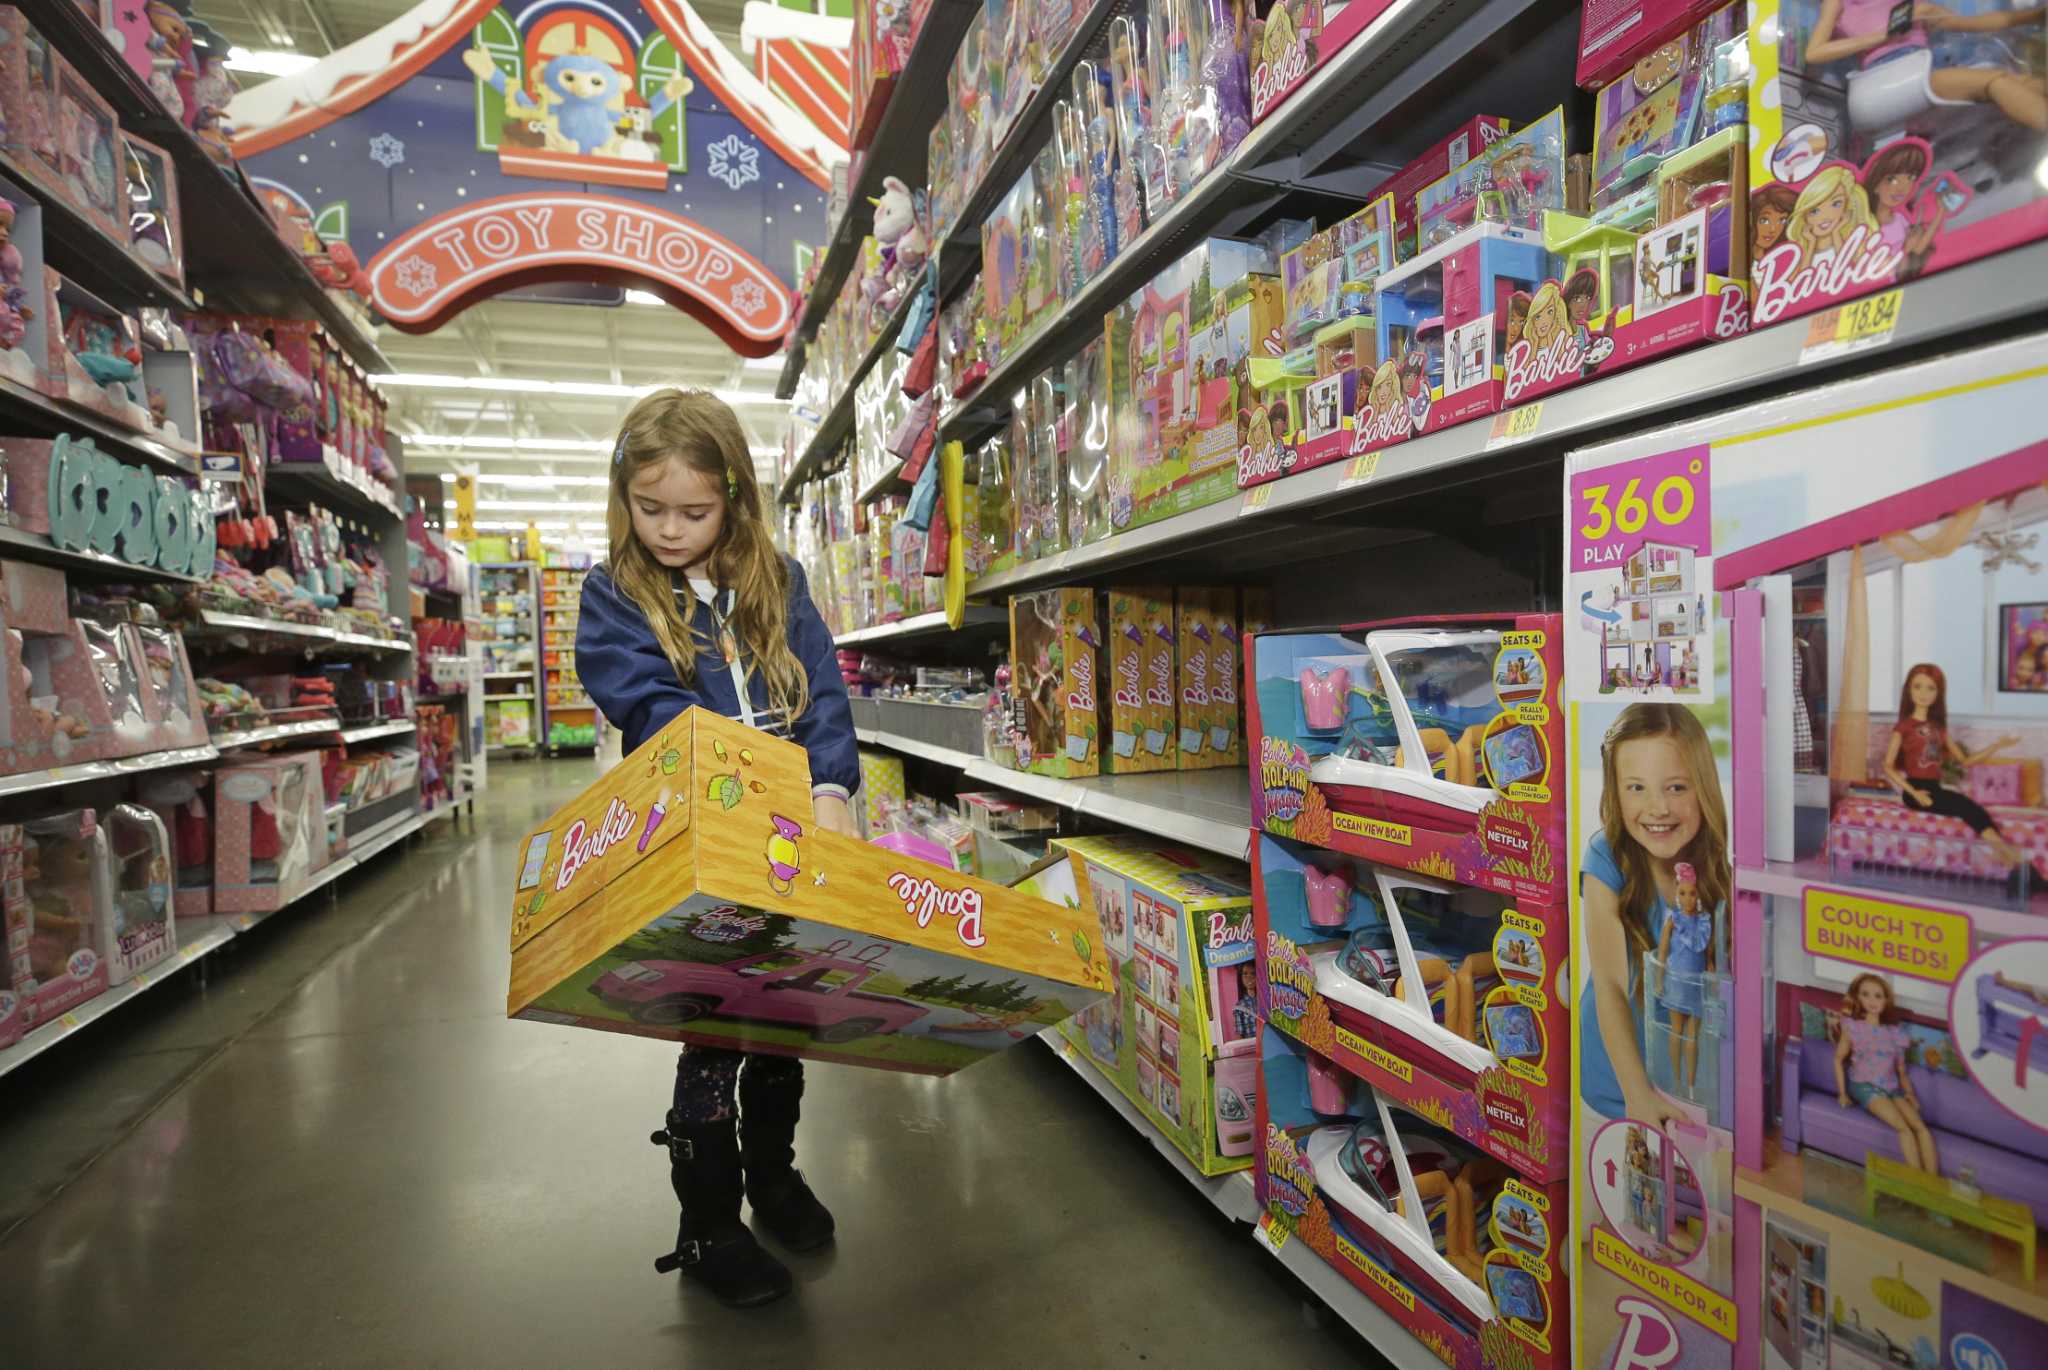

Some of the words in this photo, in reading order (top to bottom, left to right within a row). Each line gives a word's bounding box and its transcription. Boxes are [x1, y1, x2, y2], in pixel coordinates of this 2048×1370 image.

[1253, 42, 1307, 119] Barbie
[434, 208, 553, 273] TOY
[576, 207, 733, 286] SHOP
[1753, 225, 1903, 325] Barbie
[1504, 329, 1587, 400] Barbie
[1350, 400, 1412, 454] Barbie
[1237, 441, 1282, 486] Barbie
[1584, 543, 1625, 564] PLAY
[1503, 635, 1530, 646] SEATS
[1532, 635, 1542, 644] 4!
[1068, 653, 1095, 711] Barbie
[1115, 651, 1141, 709] Barbie
[1147, 650, 1173, 706] Barbie
[1184, 650, 1209, 706] Barbie
[1211, 650, 1236, 704] Barbie
[1261, 736, 1289, 766] Barbie
[1262, 766, 1307, 793] DOLPHIN
[556, 796, 637, 892] Barbie
[1335, 816, 1361, 831] OCEAN
[1364, 823, 1385, 836] VIEW
[1385, 827, 1408, 841] BOAT
[1487, 830, 1529, 850] NETFLIX
[698, 906, 767, 930] Barbie
[888, 872, 985, 948] Barbie
[1504, 914, 1529, 930] SEATS
[1822, 905, 1904, 936] COUCH
[1910, 921, 1944, 943] TO
[1818, 928, 1875, 954] BUNK
[1882, 942, 1948, 970] BEDS!
[1268, 959, 1312, 999] DOLPHIN
[1338, 1031, 1364, 1053] OCEAN
[1366, 1047, 1386, 1065] VIEW
[1386, 1058, 1408, 1077] BOAT
[1486, 1104, 1525, 1128] NETFLIX
[1267, 1150, 1313, 1200] DOLPHIN
[1505, 1181, 1534, 1203] SEATS
[1339, 1241, 1366, 1269] OCEAN
[1367, 1263, 1387, 1286] VIEW
[1388, 1280, 1411, 1305] BOAT
[1597, 1240, 1670, 1293] ELEVATOR
[1674, 1283, 1706, 1314] FOR
[1711, 1306, 1729, 1326] 4!
